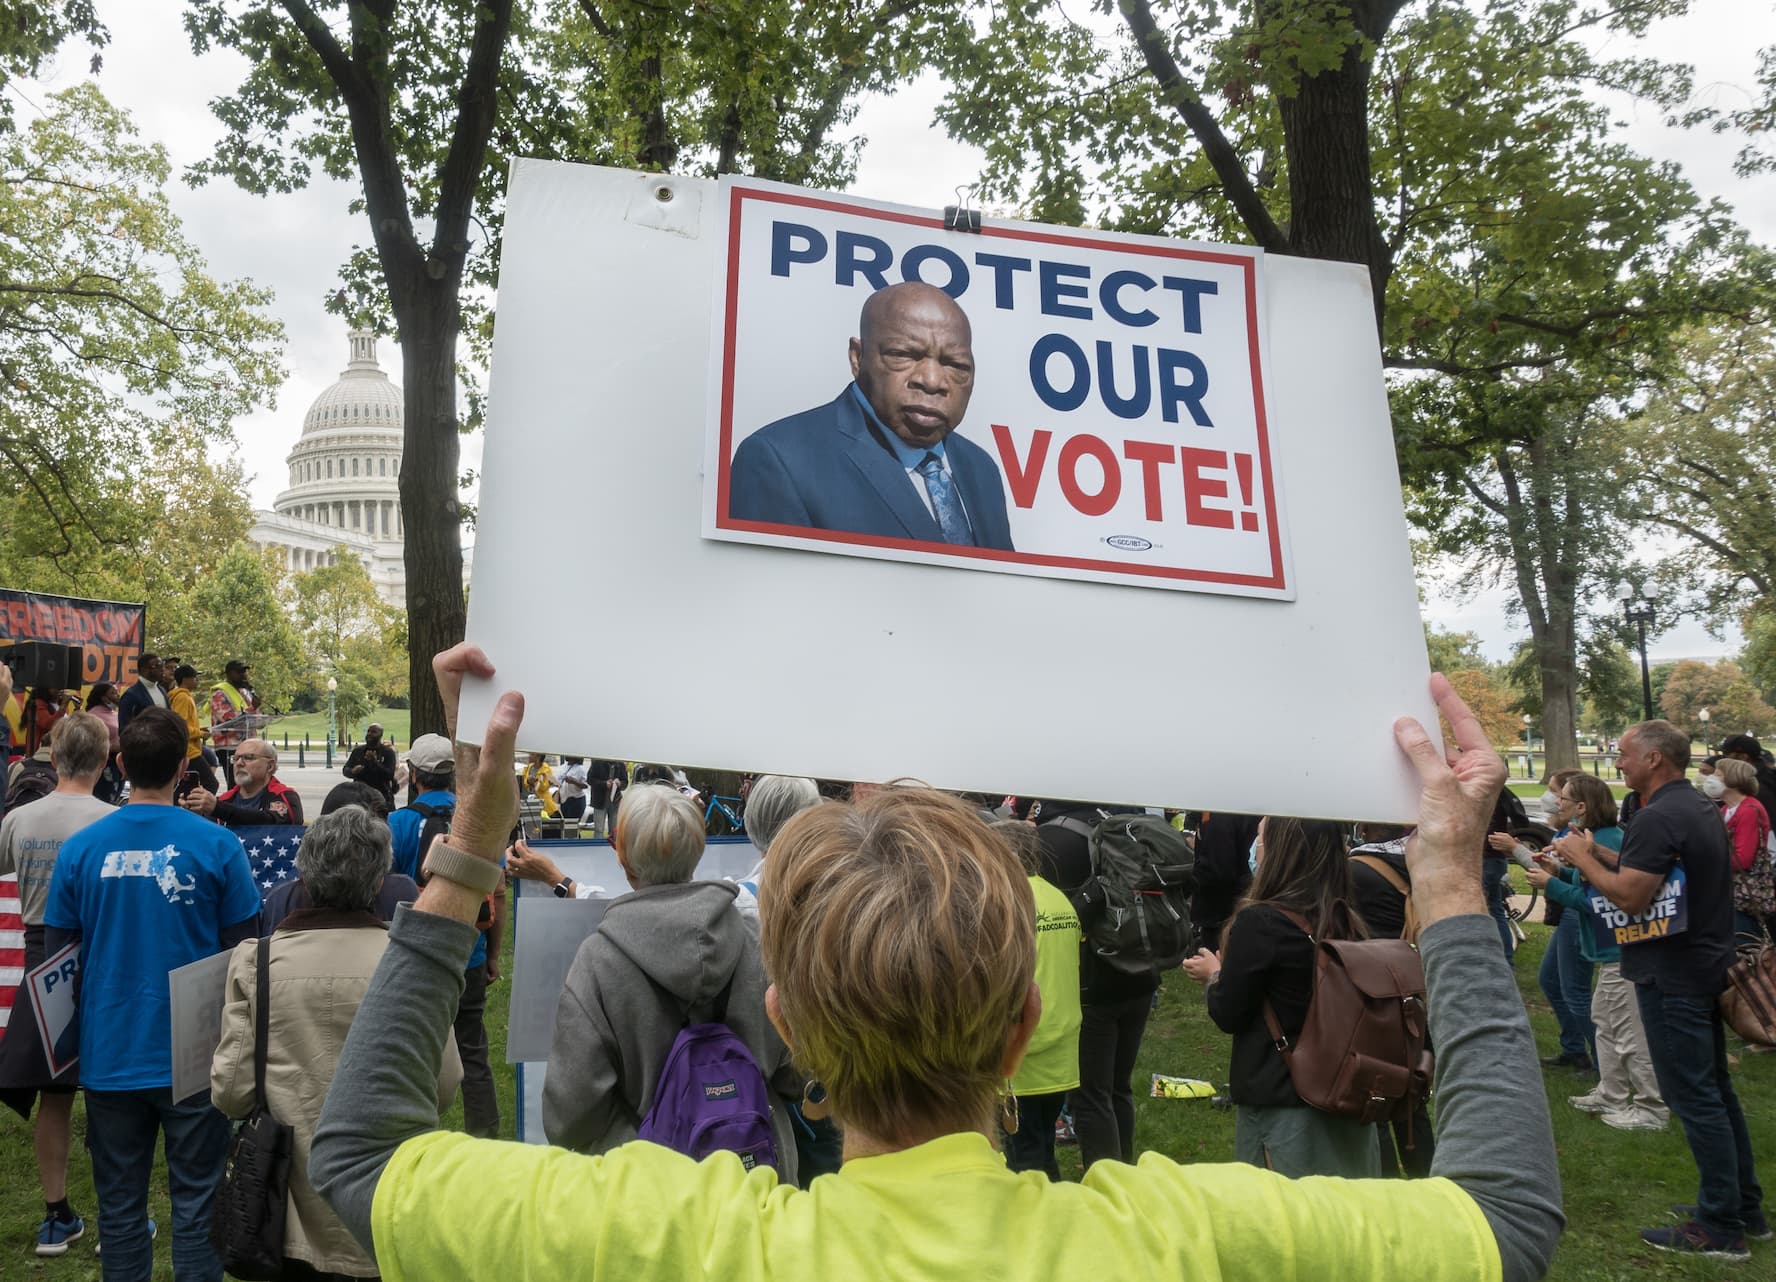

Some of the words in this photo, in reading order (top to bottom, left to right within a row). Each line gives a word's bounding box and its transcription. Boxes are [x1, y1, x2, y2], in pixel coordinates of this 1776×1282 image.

[770, 220, 1218, 334] PROTECT
[1028, 332, 1215, 428] OUR
[990, 424, 1260, 533] VOTE!
[82, 642, 139, 685] OTE
[18, 837, 64, 850] Volunte
[1601, 911, 1628, 928] TO
[1632, 899, 1677, 923] VOTE
[1614, 918, 1669, 944] RELAY
[43, 958, 79, 994] PR
